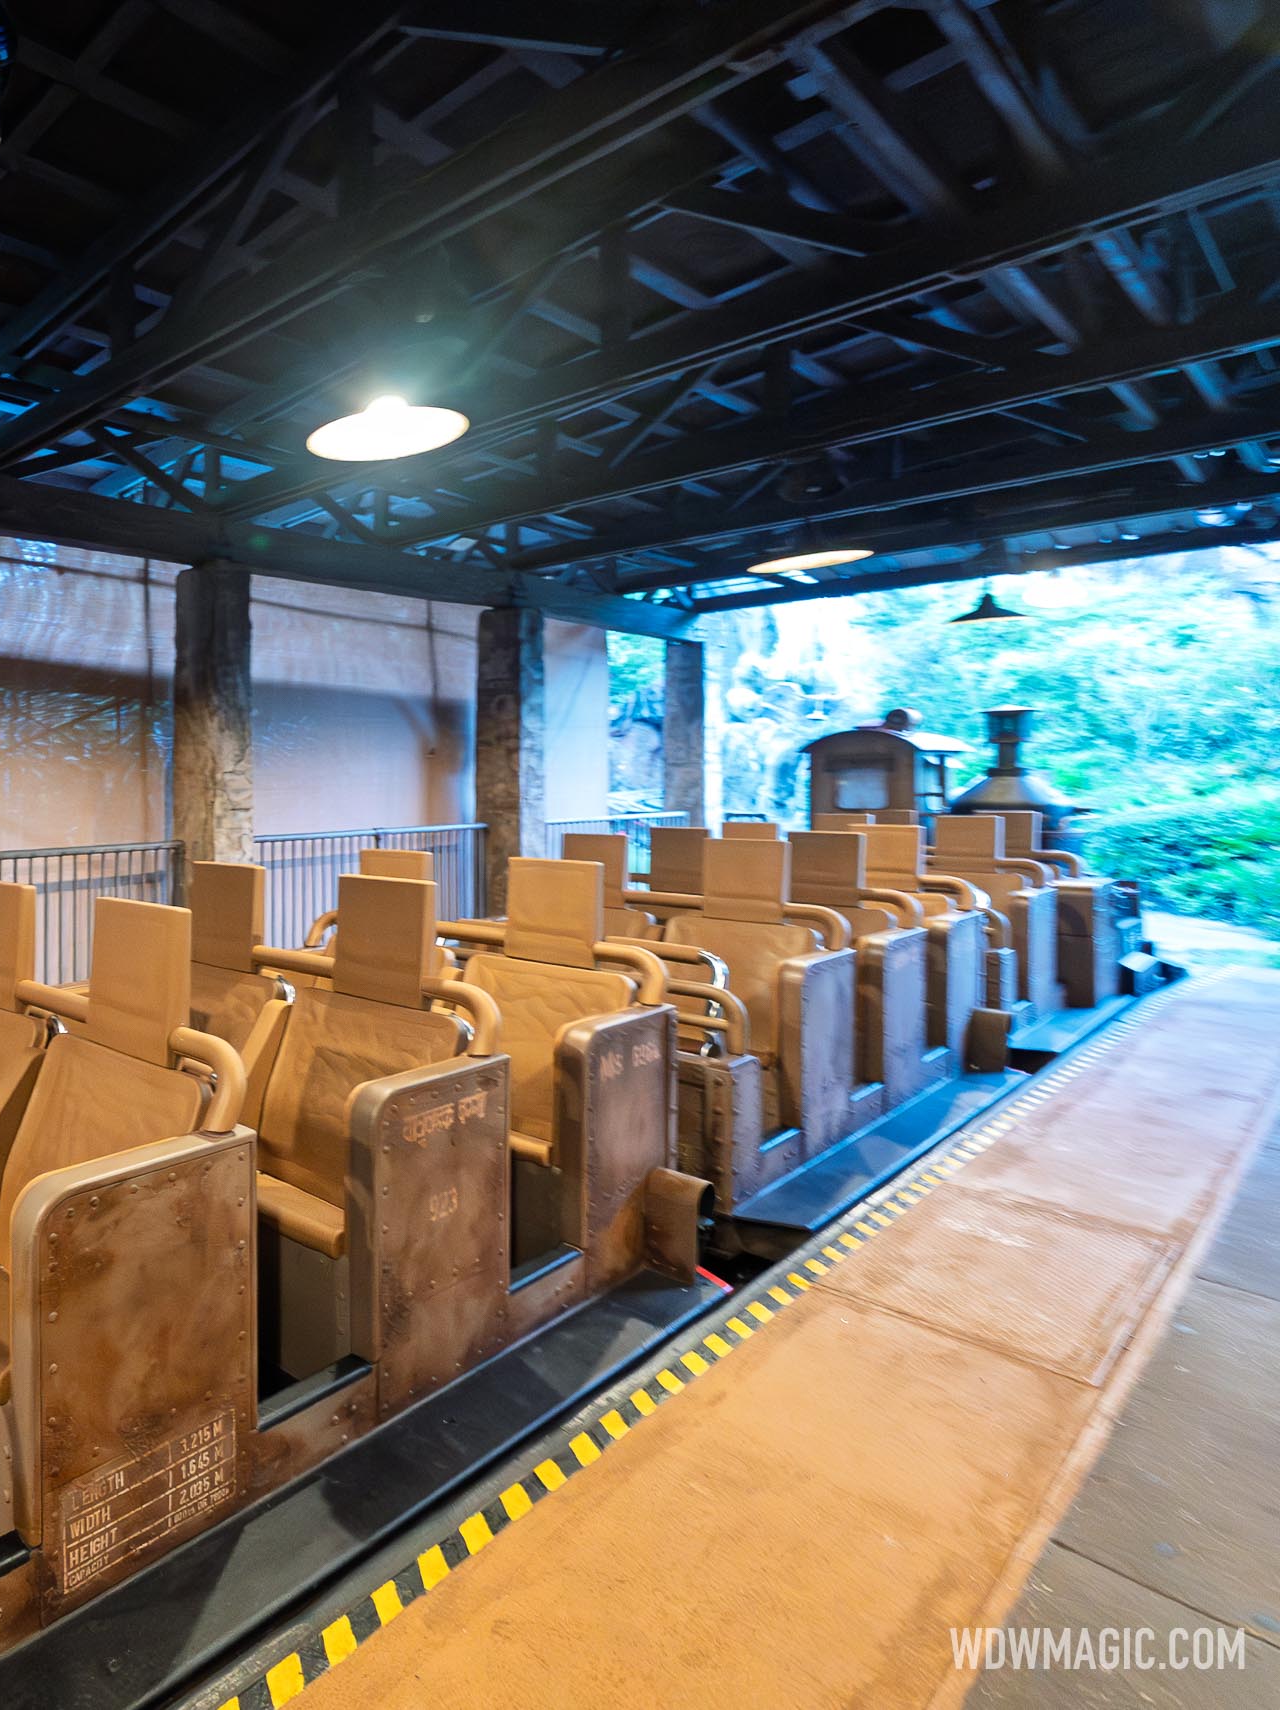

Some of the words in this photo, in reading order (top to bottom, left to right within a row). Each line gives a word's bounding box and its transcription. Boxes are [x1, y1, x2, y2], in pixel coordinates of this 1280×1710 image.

[71, 1470, 125, 1511] LENGTH
[212, 1418, 223, 1438] M
[70, 1527, 118, 1569] HEIGHT
[179, 1478, 210, 1505] 2.035
[214, 1470, 224, 1486] M
[70, 1507, 111, 1539] WIDTH
[70, 1554, 110, 1586] CAPACITY
